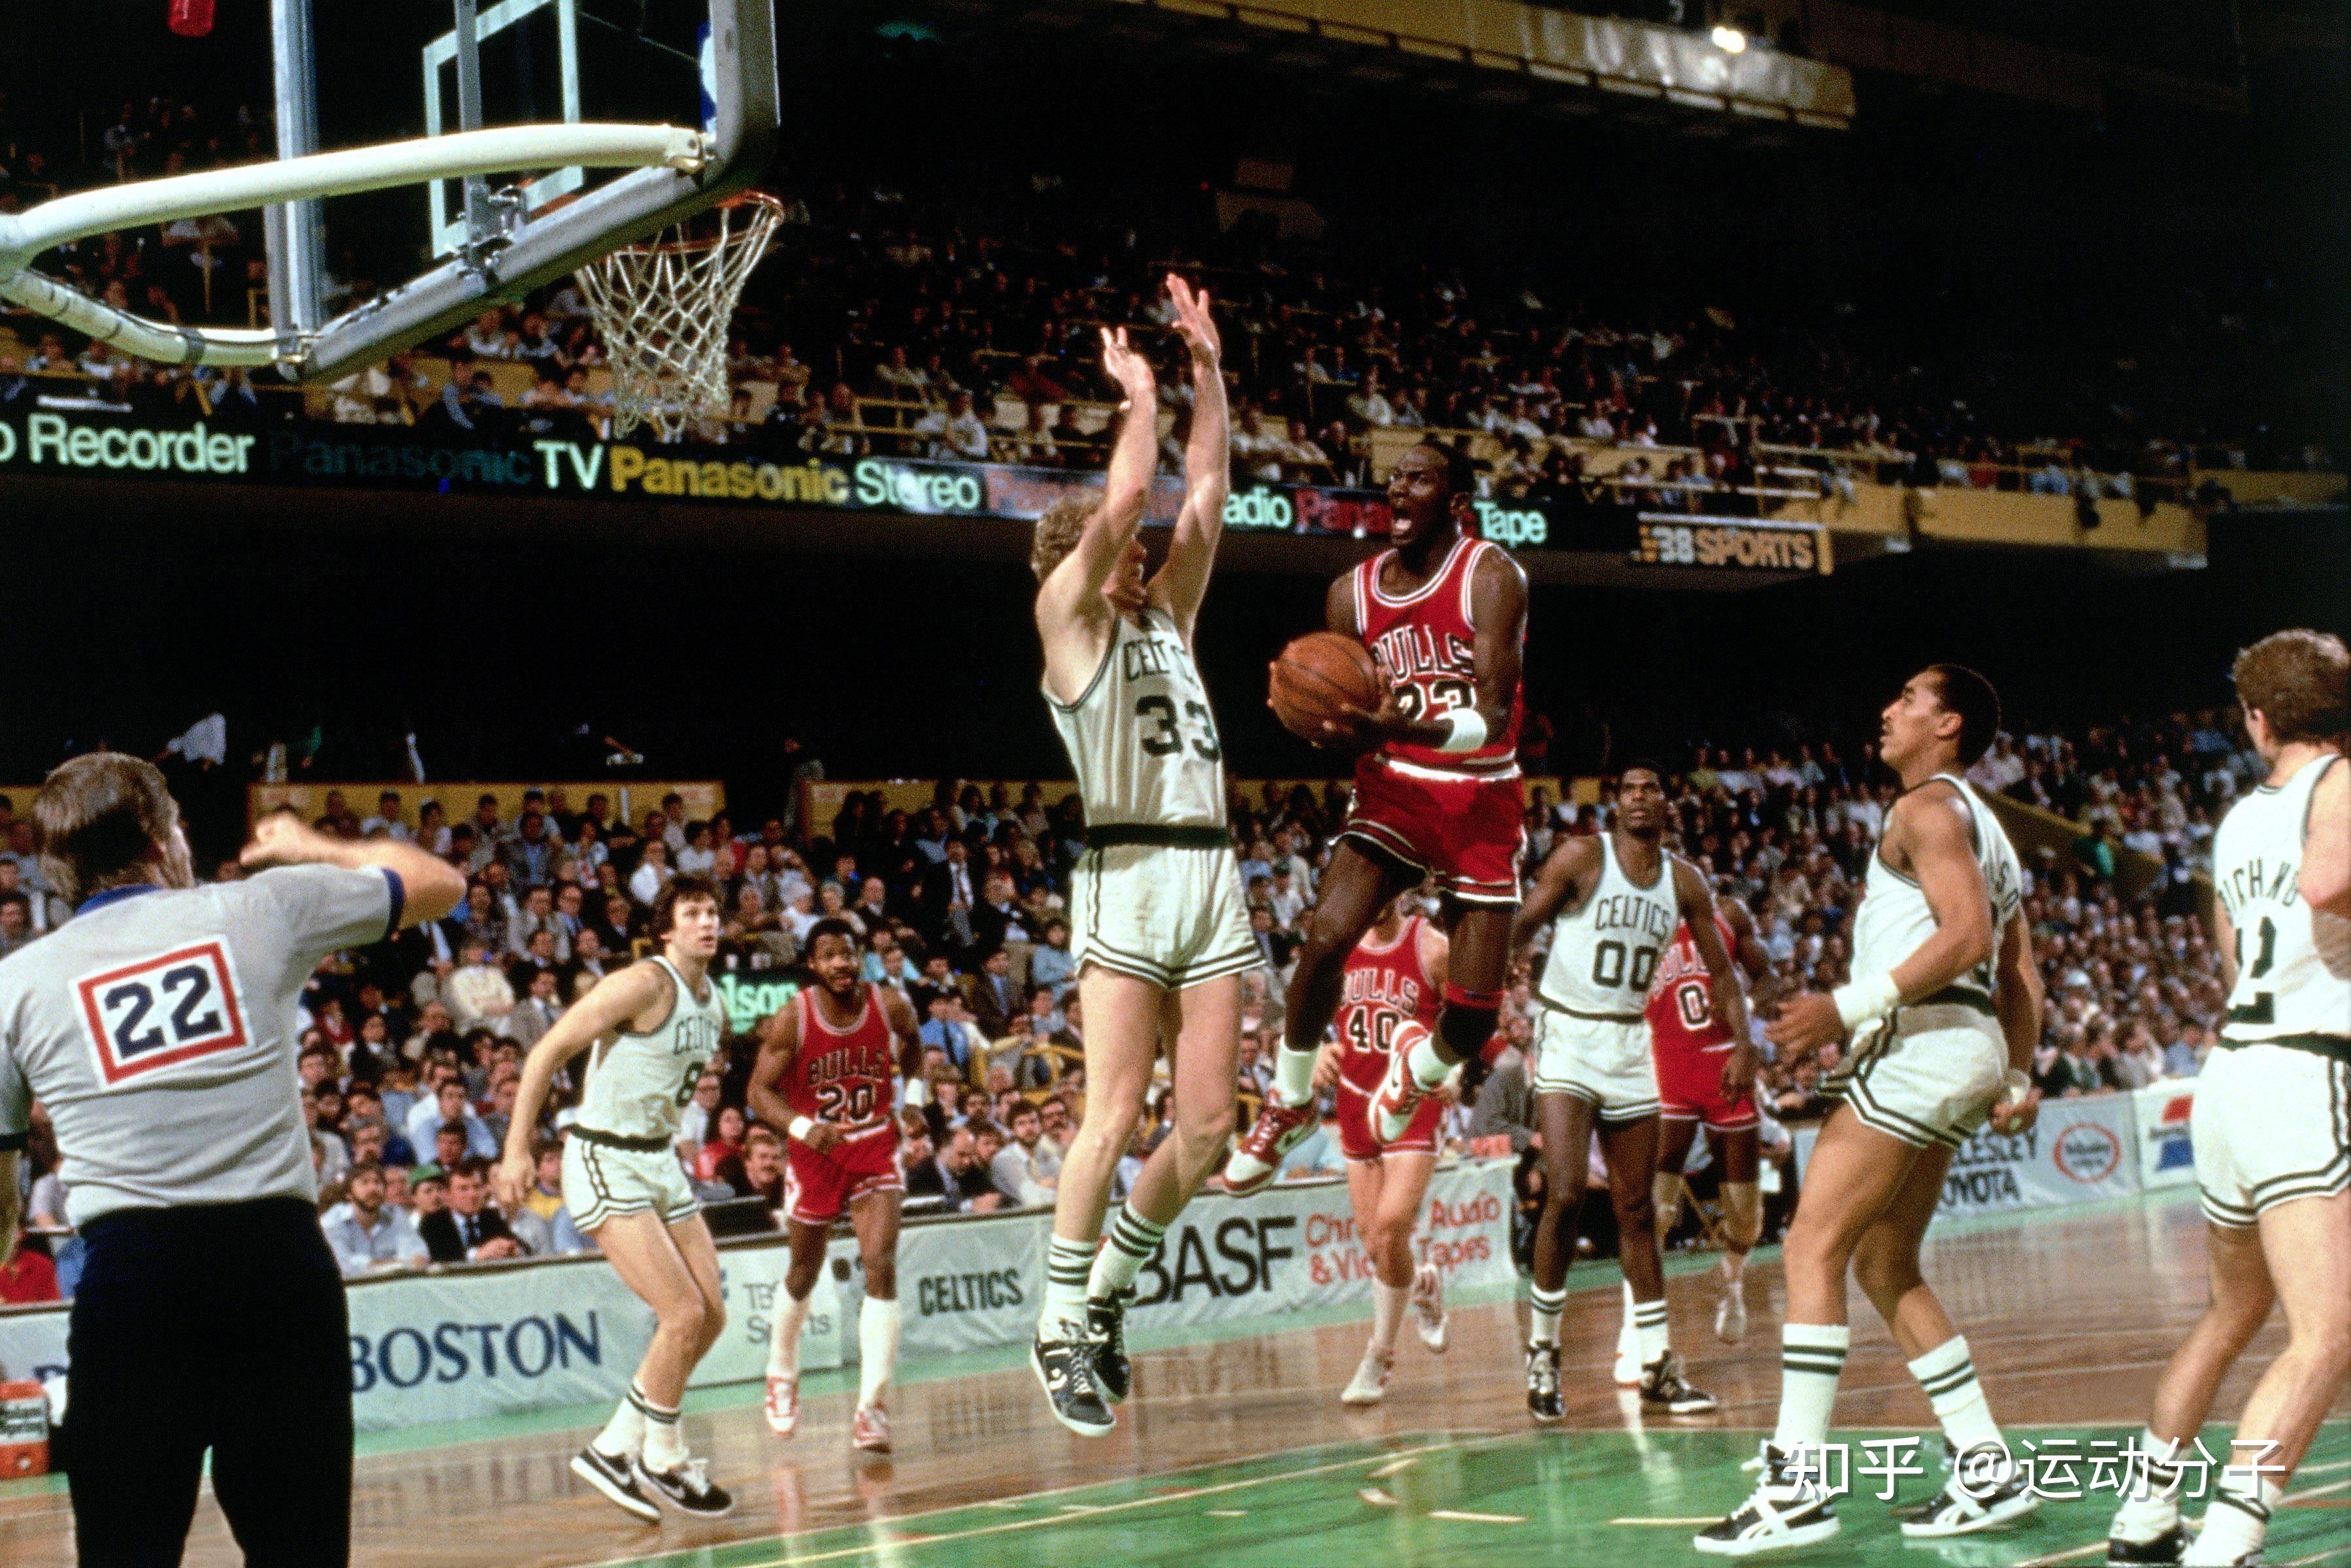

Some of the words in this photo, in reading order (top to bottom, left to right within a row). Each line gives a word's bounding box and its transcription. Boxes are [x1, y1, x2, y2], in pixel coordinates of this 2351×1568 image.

[28, 413, 256, 474] Recorder
[533, 440, 603, 489] TV
[610, 446, 849, 504] Panasonic
[856, 460, 979, 510] Stereo
[1223, 485, 1292, 527] adio
[1473, 500, 1547, 547] Tape
[1651, 526, 1694, 564] 38
[1696, 527, 1815, 570] SPORTS
[1136, 695, 1221, 762] 33
[1595, 894, 1670, 942] CELTICS
[1592, 939, 1658, 992] 00
[105, 964, 223, 1059] 22
[1343, 967, 1421, 1017] ULLS
[1347, 1005, 1402, 1053] 40
[676, 1061, 705, 1107] 8
[816, 1082, 876, 1124] 20
[1941, 1168, 2020, 1207] OYOTA
[1132, 1215, 1296, 1306] BASF
[917, 1267, 1024, 1317] CELTICS
[350, 1309, 601, 1393] BOSTON
